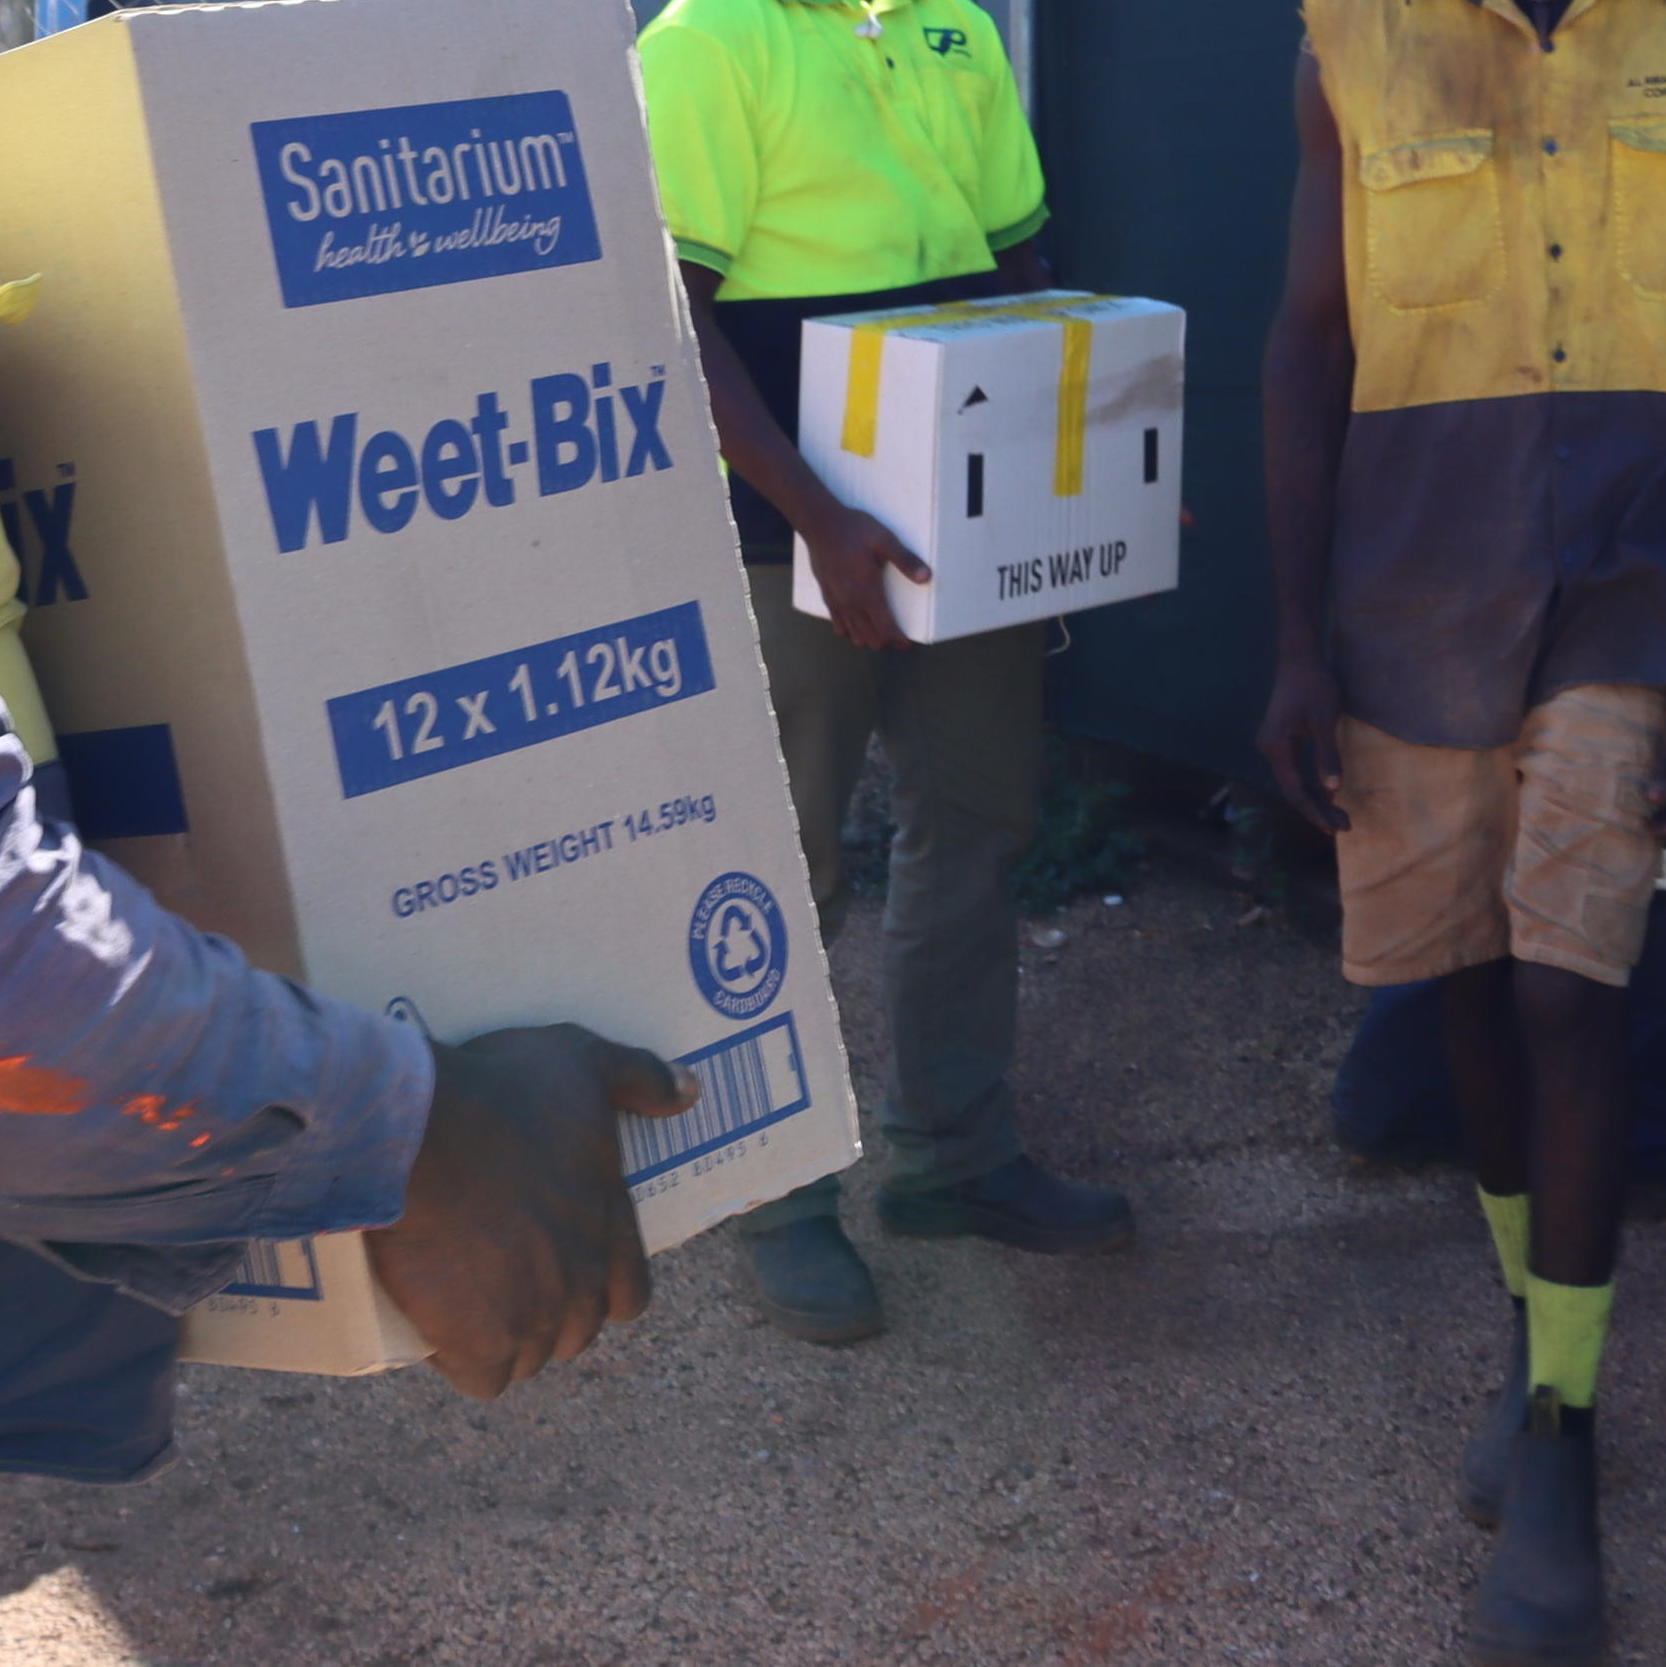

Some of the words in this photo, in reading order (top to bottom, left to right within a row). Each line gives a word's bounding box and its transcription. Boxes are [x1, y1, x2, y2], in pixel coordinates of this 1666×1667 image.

[279, 128, 568, 222] Sanitarium
[312, 222, 408, 273] health
[433, 204, 562, 256] wellbeing
[250, 362, 674, 554] Weet-Bix
[997, 557, 1043, 601] THIS
[1048, 546, 1094, 589] WAY
[1100, 540, 1127, 577] UP
[372, 691, 445, 761] 12
[455, 690, 497, 740] x
[508, 635, 684, 723] 1.12kg
[391, 860, 500, 919] GROSS
[503, 820, 616, 882] WEIGHT
[623, 793, 717, 842] 14.59kg
